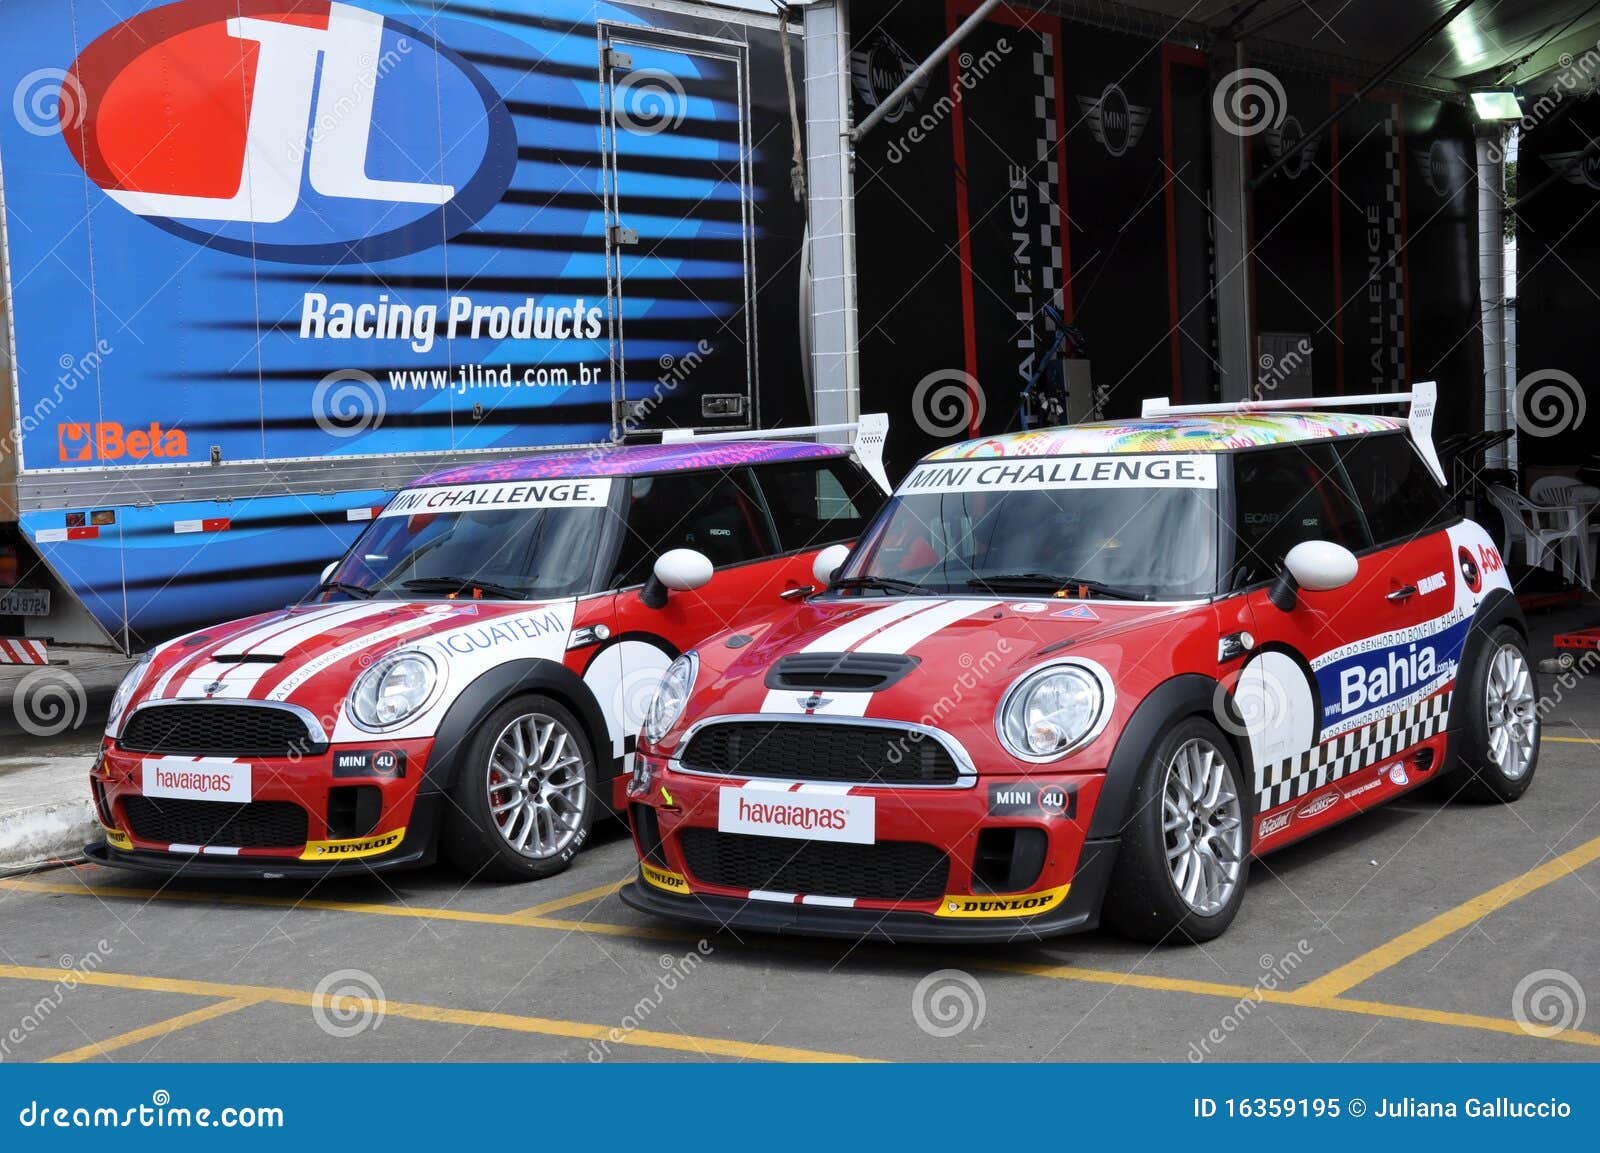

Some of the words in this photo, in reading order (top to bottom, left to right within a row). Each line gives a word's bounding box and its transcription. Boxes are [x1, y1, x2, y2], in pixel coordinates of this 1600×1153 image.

[1104, 110, 1127, 130] MINI
[299, 292, 437, 353] Racing
[446, 296, 603, 340] Products
[388, 362, 601, 394] www.jlind.com.br
[95, 421, 188, 459] Beta
[907, 467, 973, 489] MINI
[977, 460, 1205, 485] CHALLENGE.
[427, 484, 596, 508] CHALLENGE.
[436, 611, 565, 658] IGUATEMI
[1346, 644, 1358, 656] DO
[1360, 634, 1394, 652] SENHOR
[1395, 631, 1407, 644] DO
[1407, 620, 1436, 641] BONFIM
[1441, 607, 1465, 630] BAHIA
[1342, 713, 1373, 732] SENHOR
[1373, 710, 1385, 720] DO
[1418, 680, 1439, 699] BAHIA
[339, 756, 366, 767] MINI
[376, 756, 394, 767] 4U
[156, 767, 231, 792] havaianas
[739, 797, 846, 830] havaianas
[996, 791, 1031, 805] MINI
[1042, 792, 1064, 807] 4U
[326, 834, 398, 854] DUNLOP
[962, 895, 1054, 912] DUNLOP
